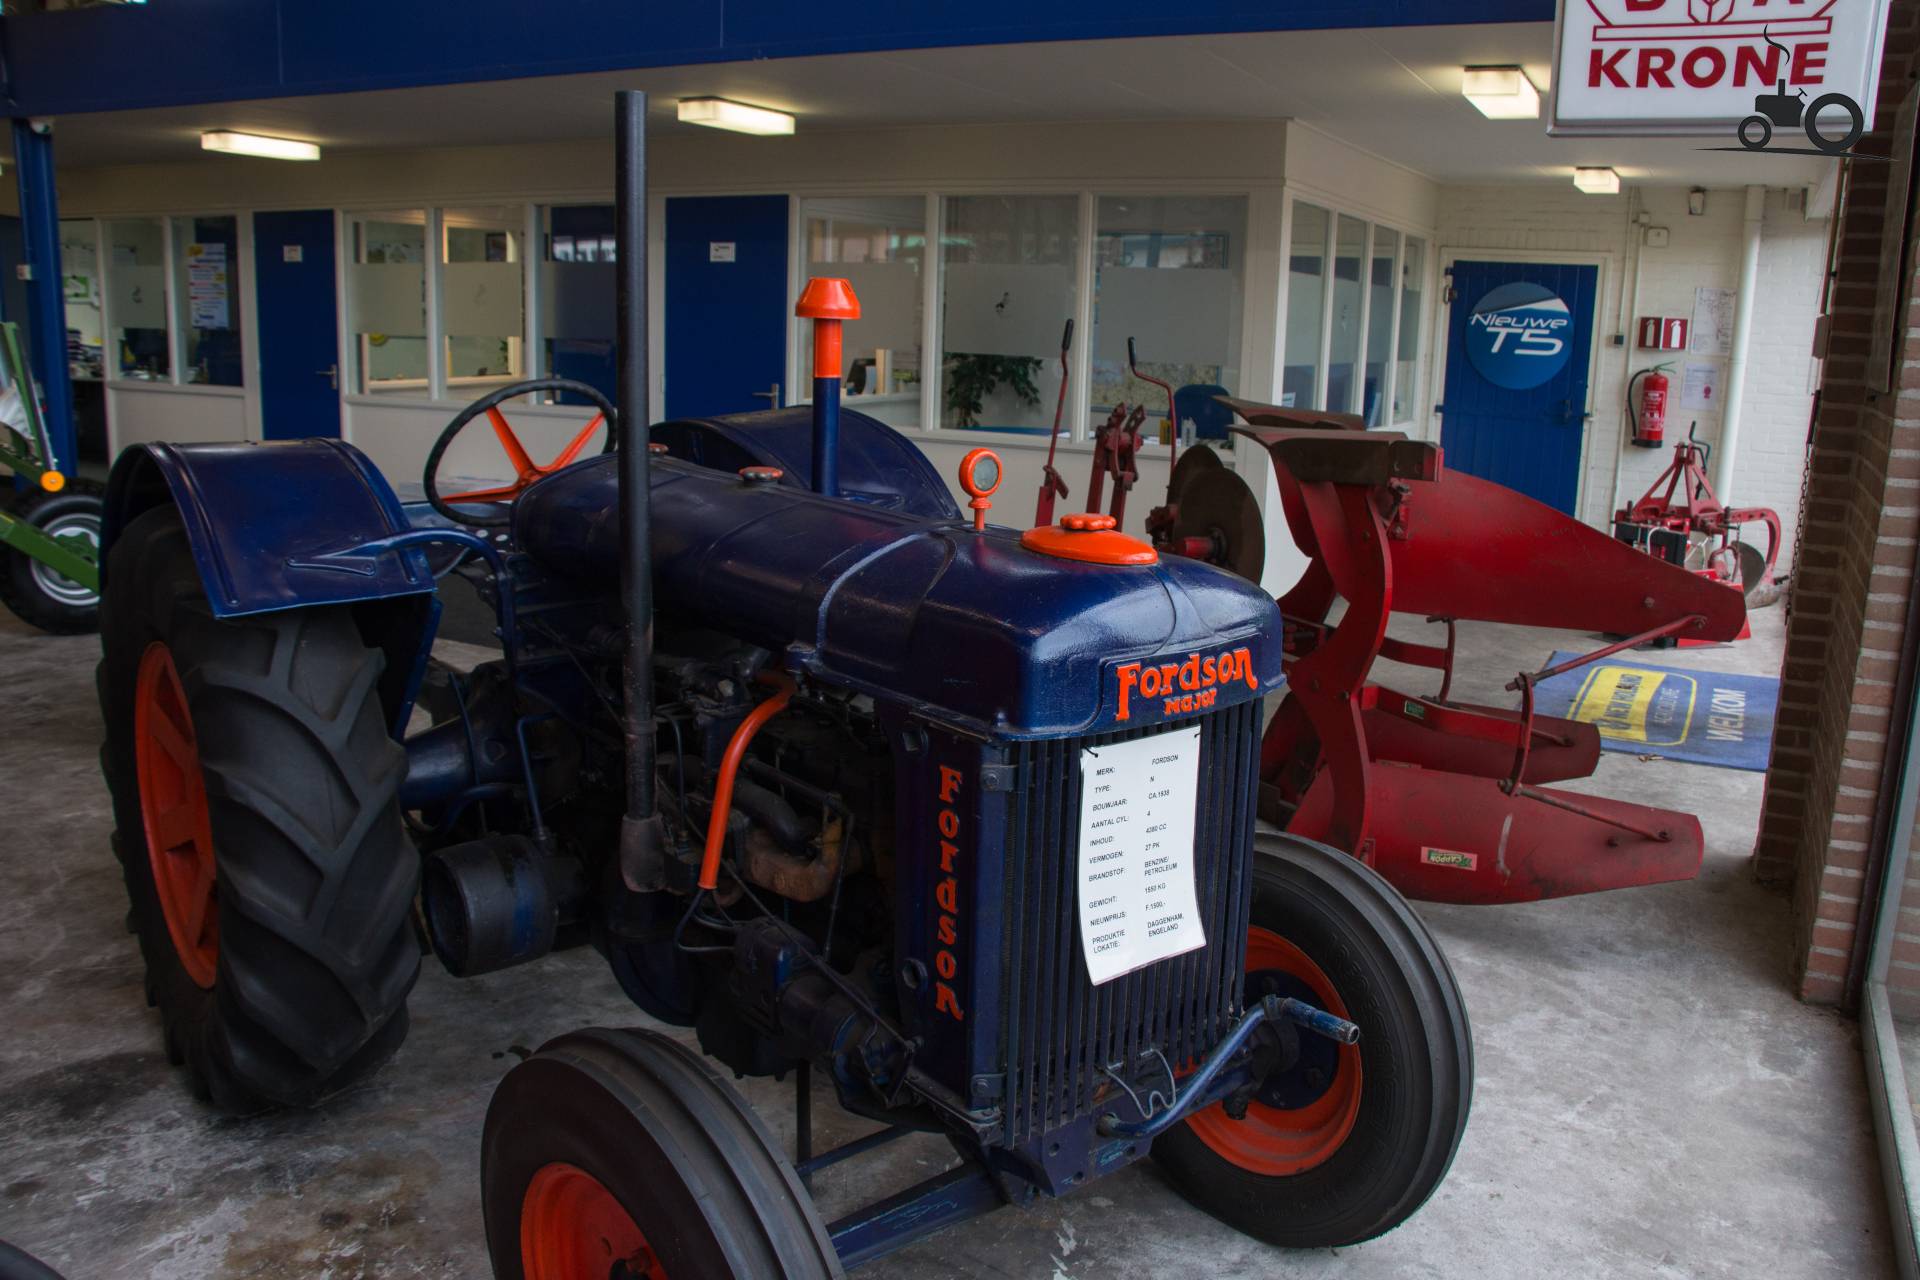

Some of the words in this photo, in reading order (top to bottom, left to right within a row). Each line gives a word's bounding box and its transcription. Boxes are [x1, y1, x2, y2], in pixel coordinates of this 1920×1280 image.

[1588, 42, 1829, 88] KRONE
[1486, 326, 1564, 356] T5
[1115, 647, 1258, 721] Fordson
[1706, 688, 1747, 741] WELKOM
[1096, 767, 1115, 776] MERK:
[1152, 754, 1178, 765] FORDSON
[1095, 785, 1111, 794] TYPE:
[1092, 799, 1127, 812] BOUWJAAR:
[1091, 818, 1114, 829] AANTAL
[1090, 836, 1114, 846] INHOUD:
[1089, 850, 1124, 864] VERMOGEN:
[1145, 856, 1169, 867] BENZINE/
[1144, 863, 1177, 876] PETROLEUM
[936, 764, 964, 1021] Fordson
[1089, 896, 1117, 908] GEWICHT:
[1090, 911, 1127, 927] NIEUWPRIJS:
[1092, 929, 1125, 944] PRODUKTIE
[1094, 941, 1120, 953] LOKATIE:
[1148, 923, 1178, 937] ENGELAND
